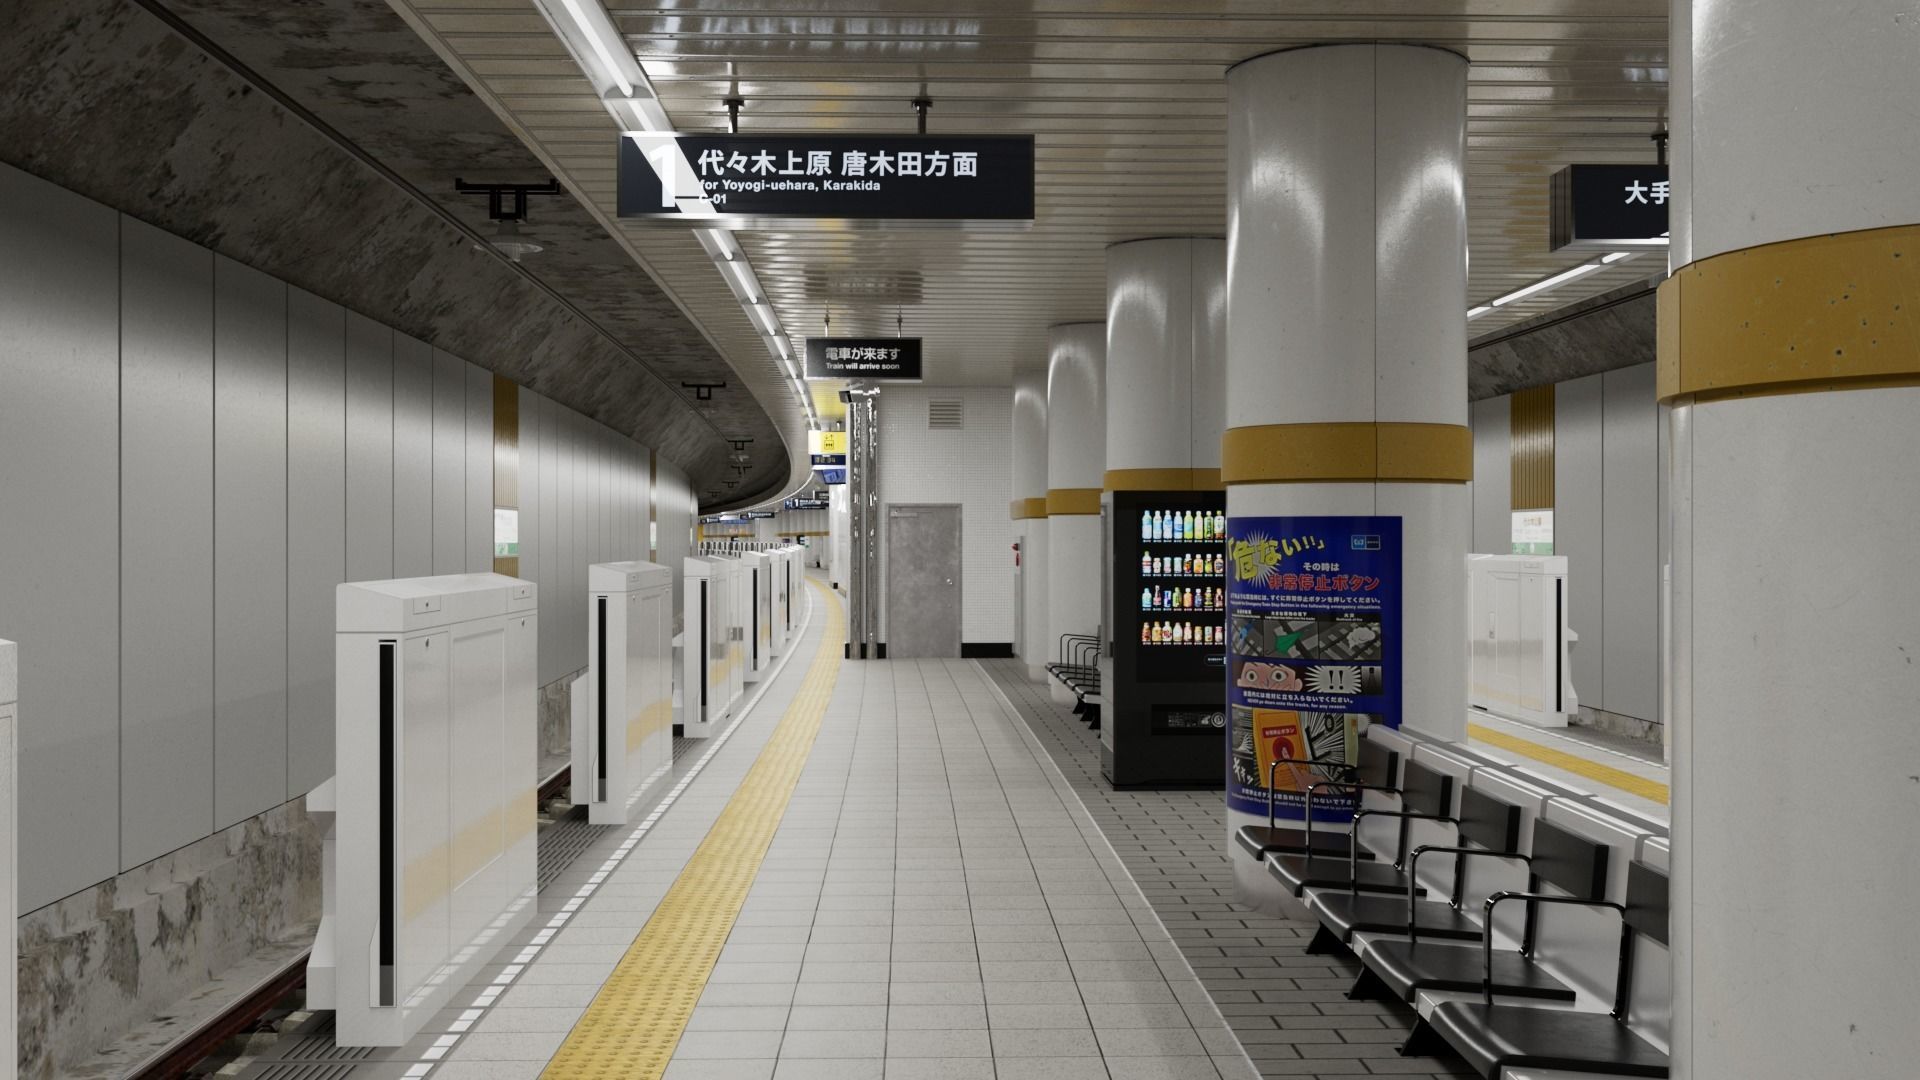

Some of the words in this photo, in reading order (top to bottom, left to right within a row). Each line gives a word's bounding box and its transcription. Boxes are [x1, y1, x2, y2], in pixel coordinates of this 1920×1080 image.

[698, 149, 832, 175] 代々木上原
[841, 150, 978, 177] 唐木田方面
[649, 144, 675, 207] 1
[700, 179, 718, 190] for
[722, 179, 819, 192] Yoyogi-uehara,
[823, 179, 881, 191] Karakida
[825, 347, 901, 361] 電車が来ます
[826, 362, 844, 370] Train
[845, 362, 858, 370] will
[859, 362, 880, 370] arrive
[1303, 562, 1340, 572] その時は
[1268, 573, 1380, 592] 非常停止ボタン
